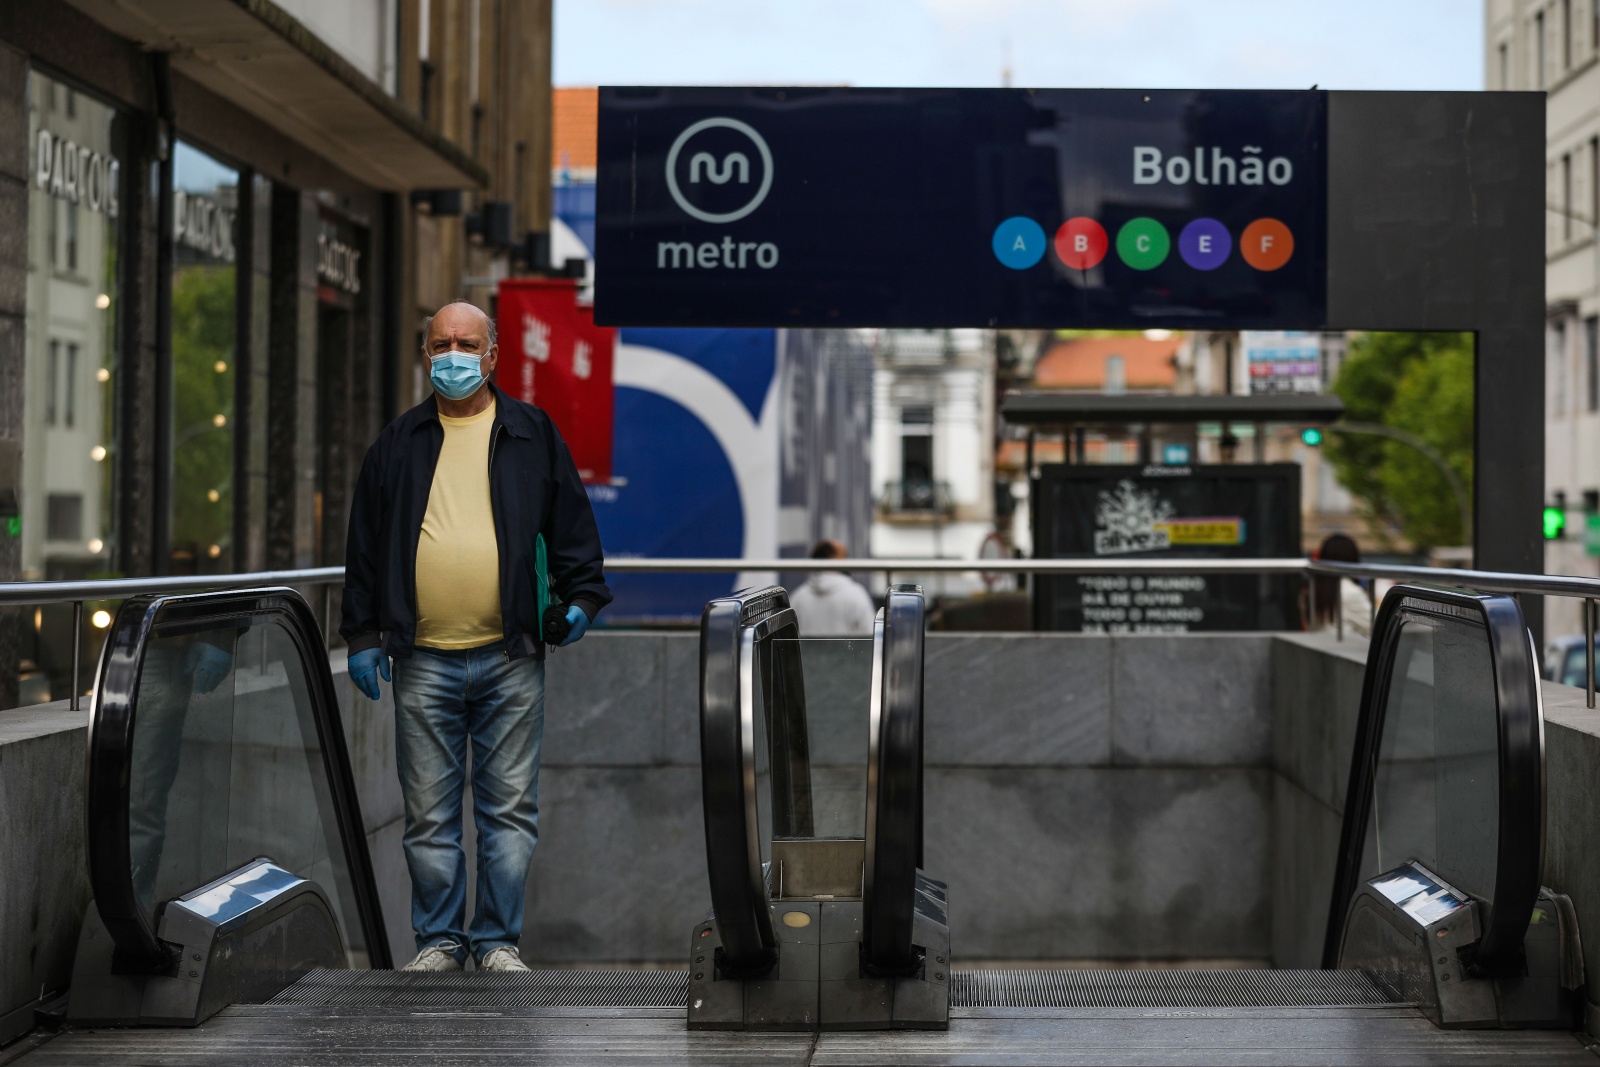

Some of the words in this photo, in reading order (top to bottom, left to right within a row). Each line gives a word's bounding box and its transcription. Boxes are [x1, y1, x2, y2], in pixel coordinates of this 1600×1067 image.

[1133, 146, 1294, 187] Bolhão
[656, 236, 780, 270] metro
[1012, 234, 1027, 252] A
[1074, 234, 1089, 253] B
[1136, 235, 1151, 253] C
[1199, 235, 1213, 253] E
[1260, 235, 1275, 254] F
[1130, 576, 1146, 592] O
[1146, 576, 1206, 592] MUNDO
[1108, 591, 1131, 607] DE
[1082, 607, 1127, 622] TODO
[1128, 607, 1144, 622] O
[1145, 607, 1204, 622] MUNDO
